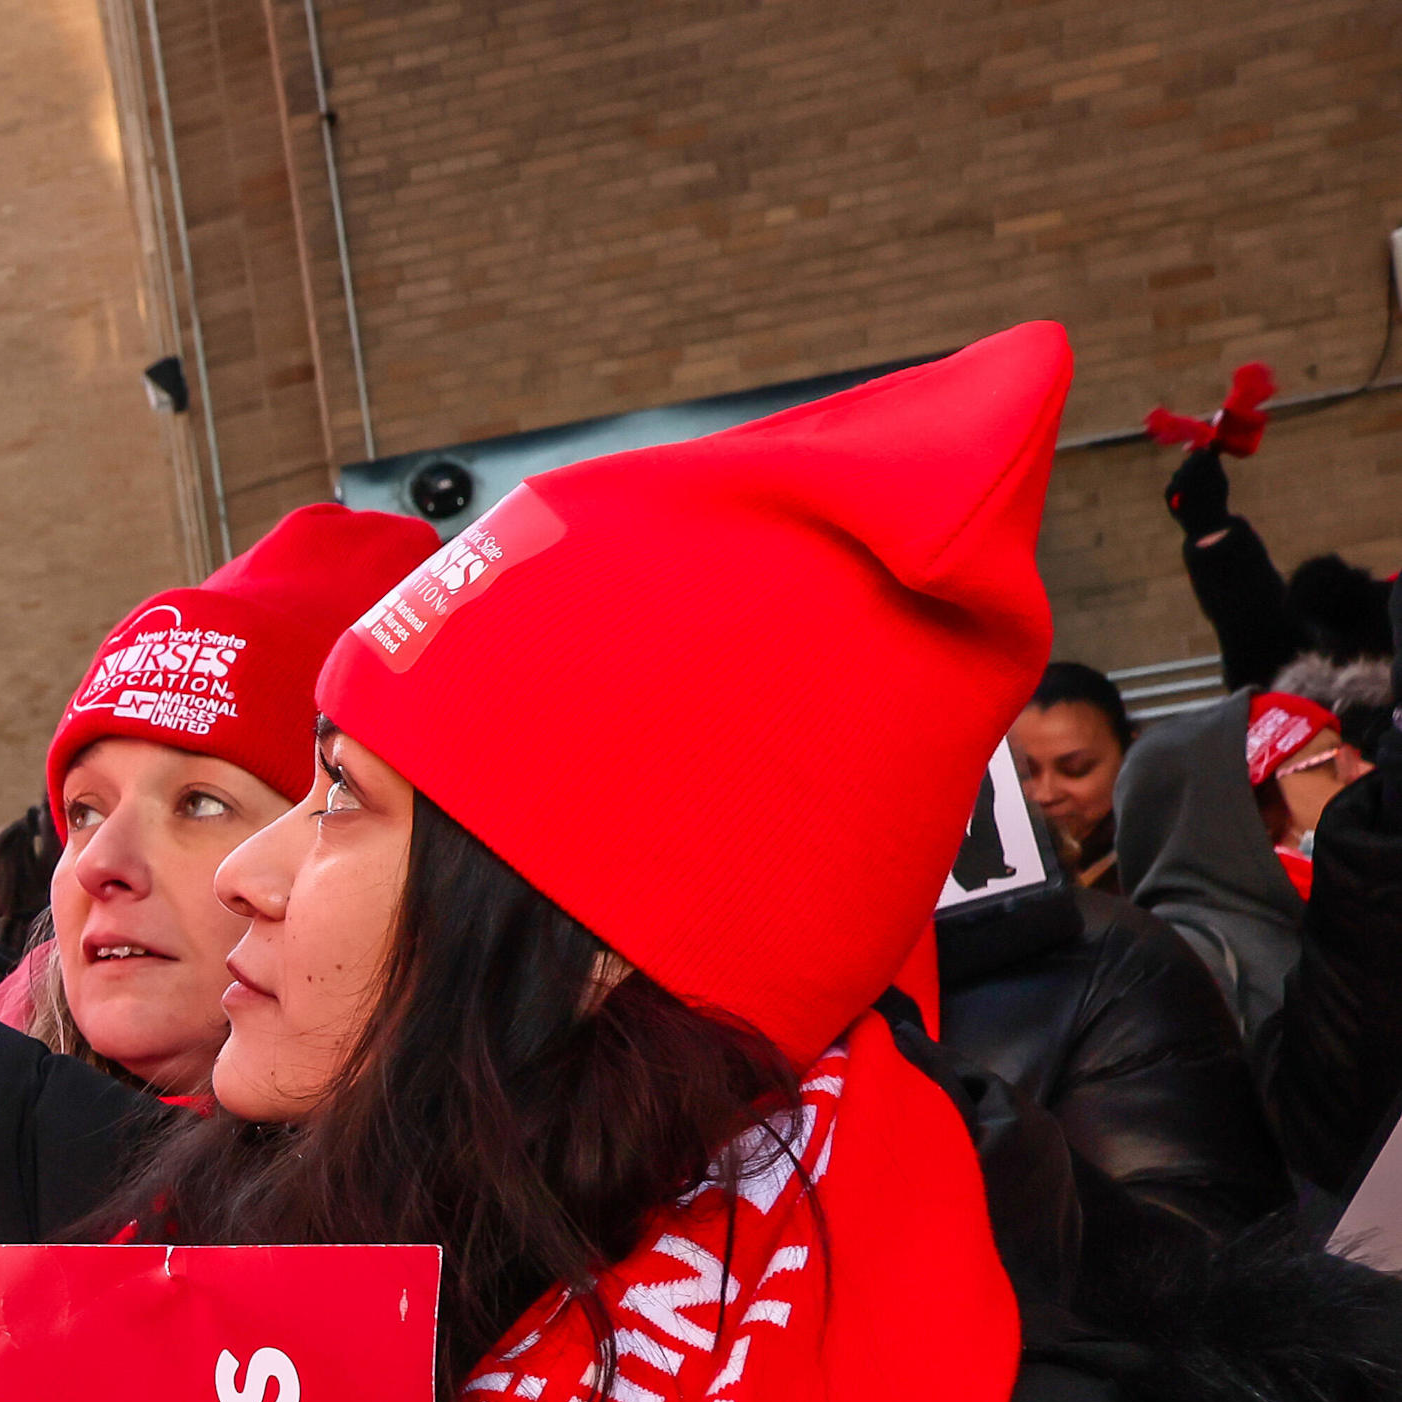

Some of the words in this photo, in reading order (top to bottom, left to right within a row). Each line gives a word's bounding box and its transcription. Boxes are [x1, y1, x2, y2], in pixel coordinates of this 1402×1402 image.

[476, 536, 504, 562] State
[382, 610, 411, 642] Nurses
[394, 599, 428, 635] National
[134, 630, 168, 645] New
[168, 627, 203, 643] York
[204, 630, 247, 650] State
[370, 623, 401, 655] United
[93, 641, 237, 685] NURSES
[154, 702, 217, 725] NURSES
[160, 690, 239, 718] NATIONAL
[150, 711, 210, 736] UNITED
